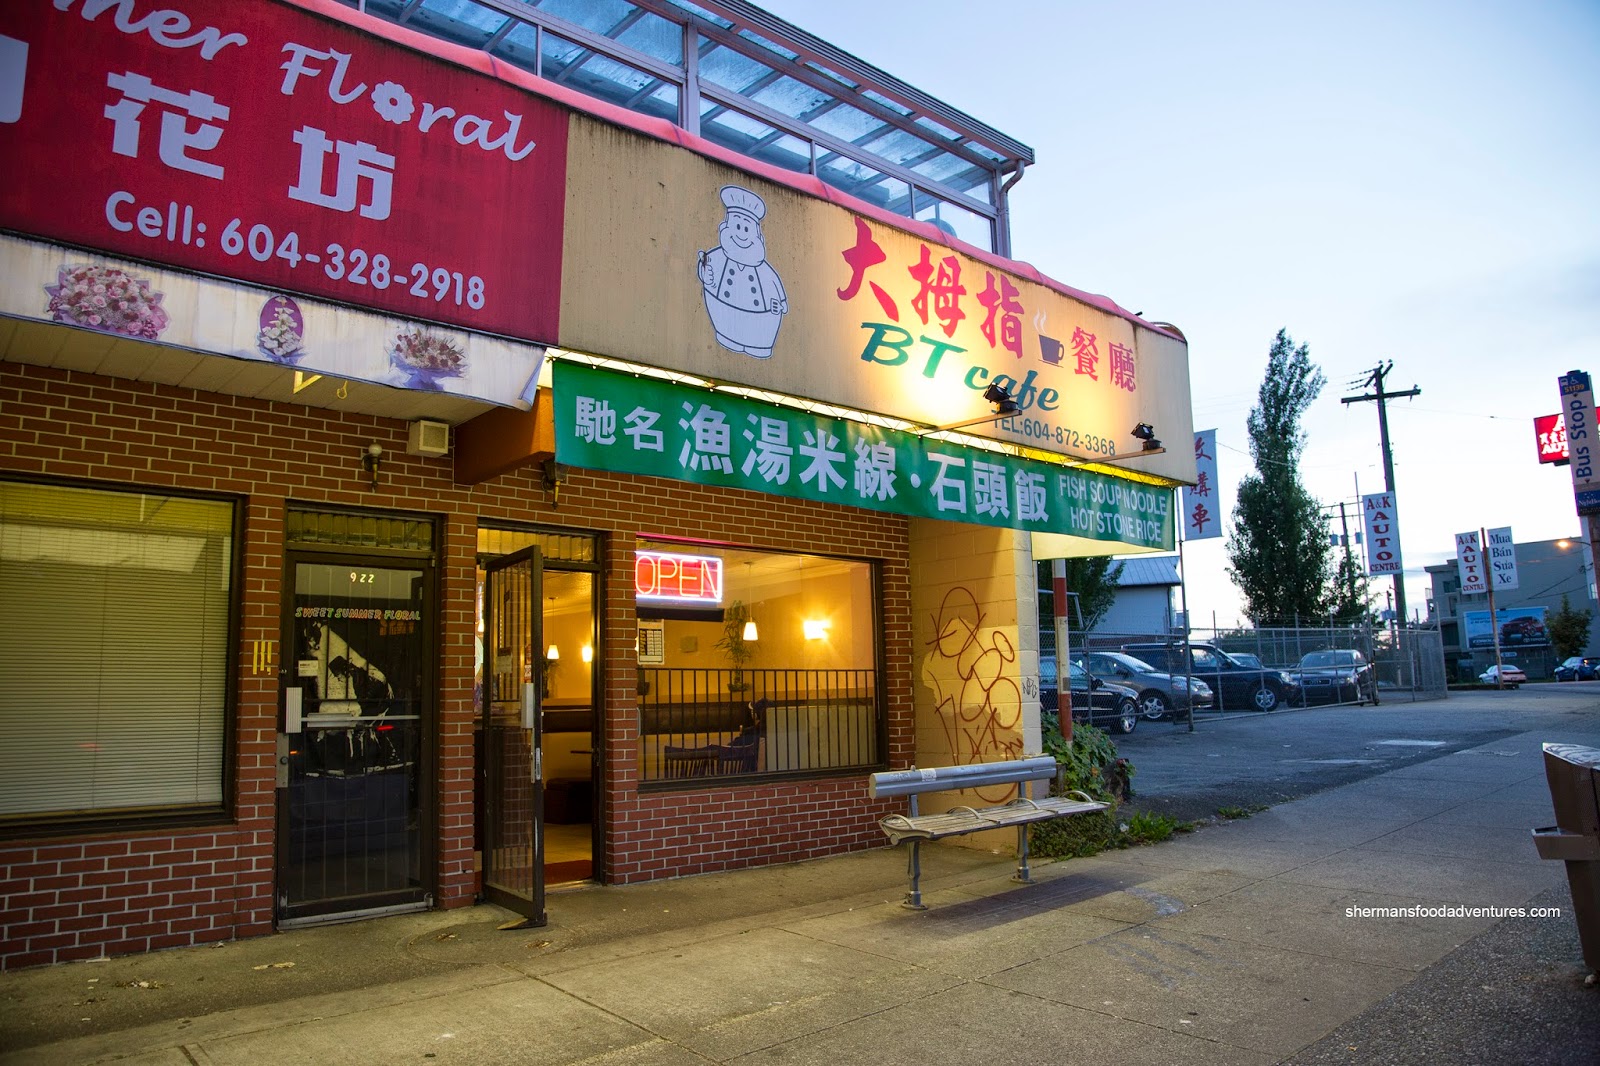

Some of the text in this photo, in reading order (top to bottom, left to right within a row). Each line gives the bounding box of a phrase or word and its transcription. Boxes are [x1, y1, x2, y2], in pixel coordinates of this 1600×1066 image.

[105, 190, 486, 311] Cell: 604-328-2918
[837, 216, 1024, 360] 大拇指
[860, 322, 1060, 413] BT cafe
[1070, 325, 1137, 393] 餐廳
[1569, 399, 1588, 441] Stop
[1575, 446, 1593, 478] Bus
[1059, 474, 1167, 516] FISH SOUP NOODLE
[1366, 496, 1392, 510] A&K
[1070, 506, 1162, 543] HOT STONE RICE
[1371, 511, 1393, 561] AUTO
[1458, 534, 1477, 545] A&K
[1490, 534, 1511, 545] Mua
[350, 572, 375, 583] 922
[635, 555, 720, 598] OPEN
[1369, 562, 1400, 572] CENTRE
[1498, 573, 1512, 584] Xe
[1462, 583, 1485, 591] CENTRE
[295, 606, 421, 621] SWEET SUMMER FLORAL
